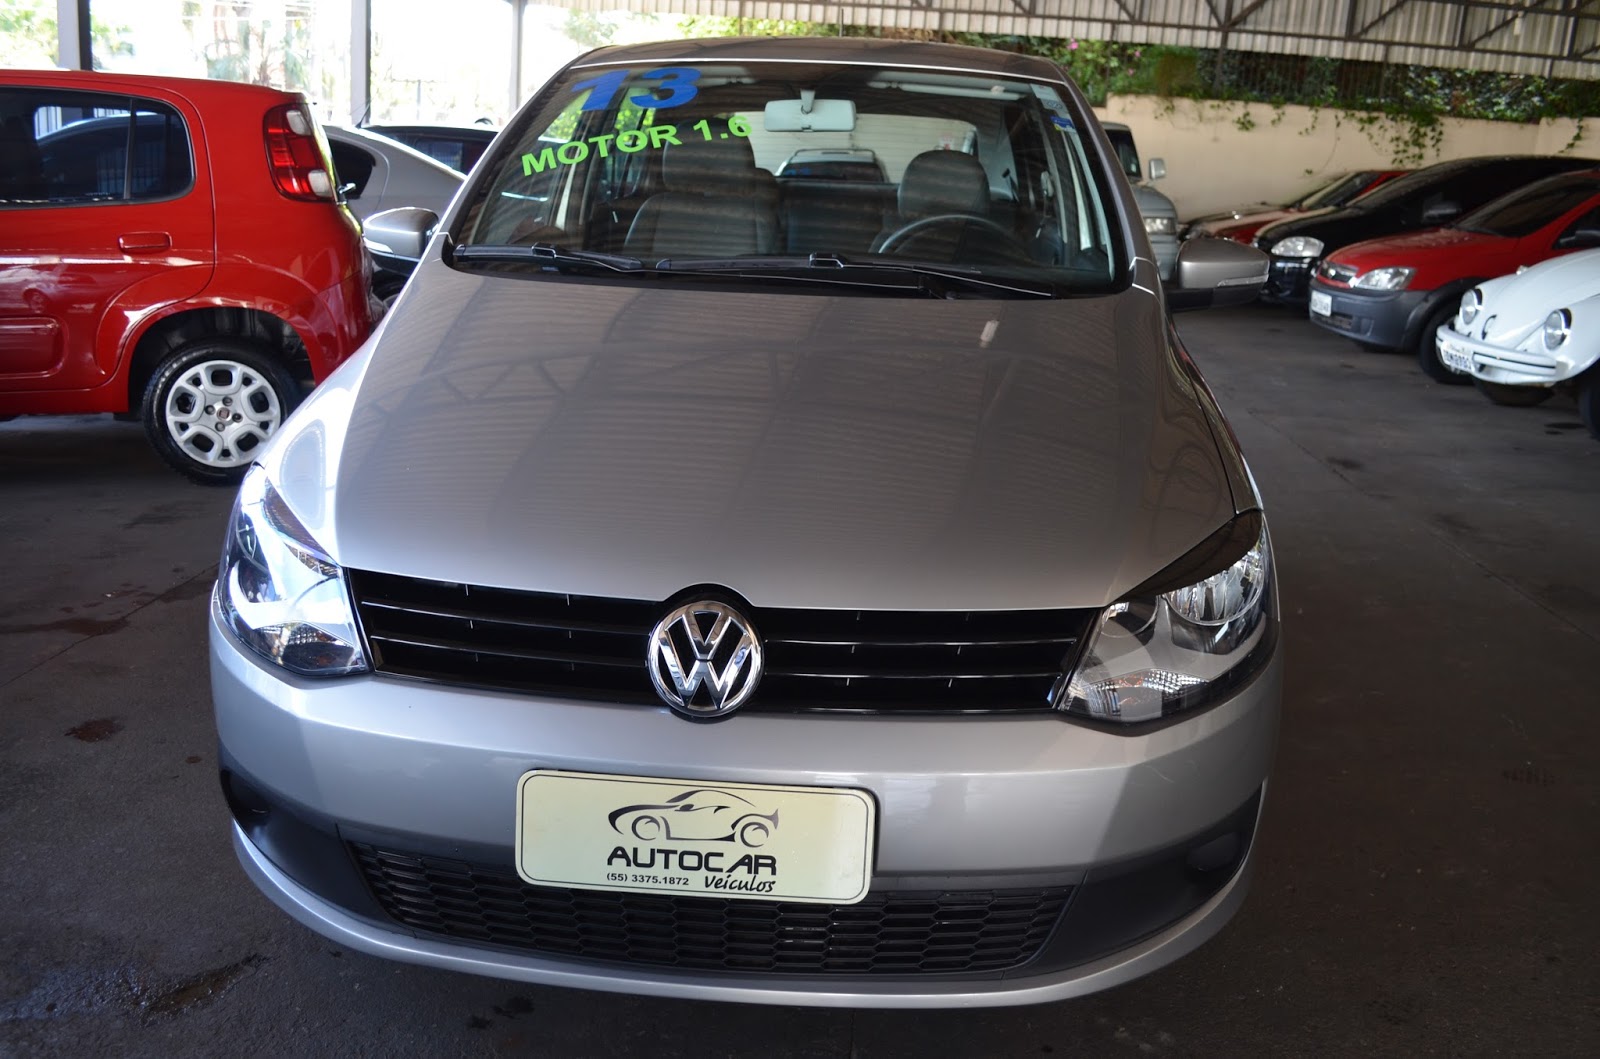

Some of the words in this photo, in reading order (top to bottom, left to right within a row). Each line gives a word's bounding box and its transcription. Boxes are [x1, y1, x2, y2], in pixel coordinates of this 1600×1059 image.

[571, 67, 702, 111] 13
[521, 124, 682, 177] MOTOR
[693, 115, 752, 142] 1.6
[607, 846, 777, 876] AUTOCAR
[606, 872, 628, 882] (55)
[631, 874, 689, 886] 3375.1872
[704, 873, 776, 893] Veículos
